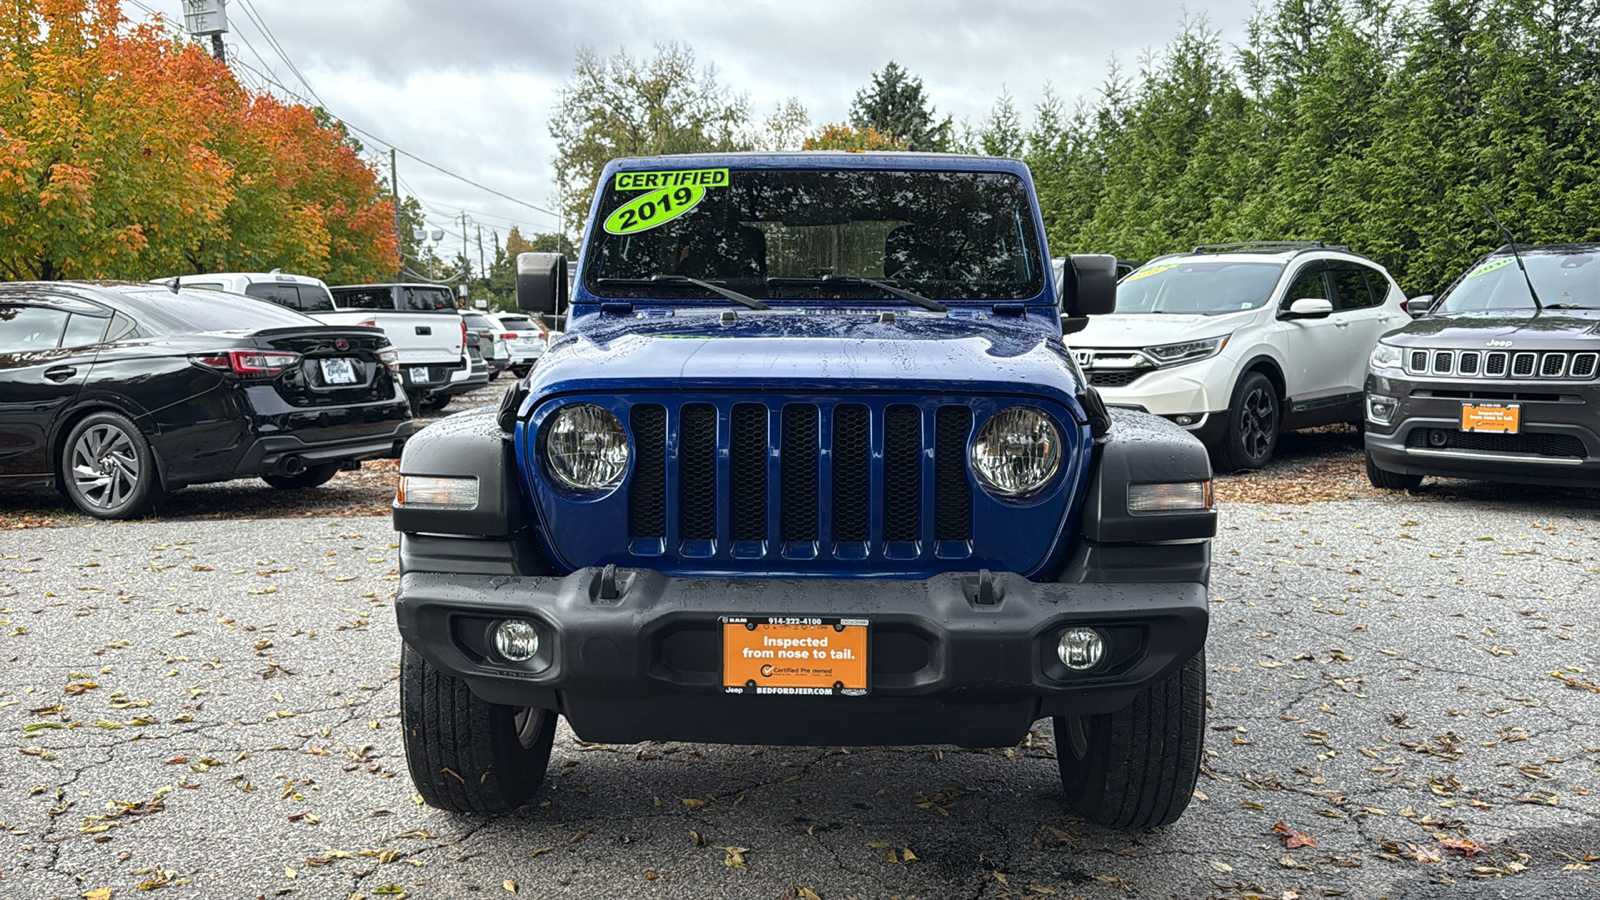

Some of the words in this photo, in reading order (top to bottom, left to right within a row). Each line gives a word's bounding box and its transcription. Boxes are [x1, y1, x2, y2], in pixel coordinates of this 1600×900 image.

[618, 171, 725, 188] CERTIFIED
[618, 187, 692, 231] 2019
[1486, 339, 1513, 348] Jeep
[768, 617, 822, 625] 914-222-4100
[763, 636, 828, 649] Inspected
[742, 648, 774, 659] from
[778, 650, 809, 659] nose
[812, 648, 827, 659] to
[830, 648, 855, 660] tail.
[725, 686, 744, 694] Jeep
[756, 687, 833, 695] BEDFORDJEEP.COM
